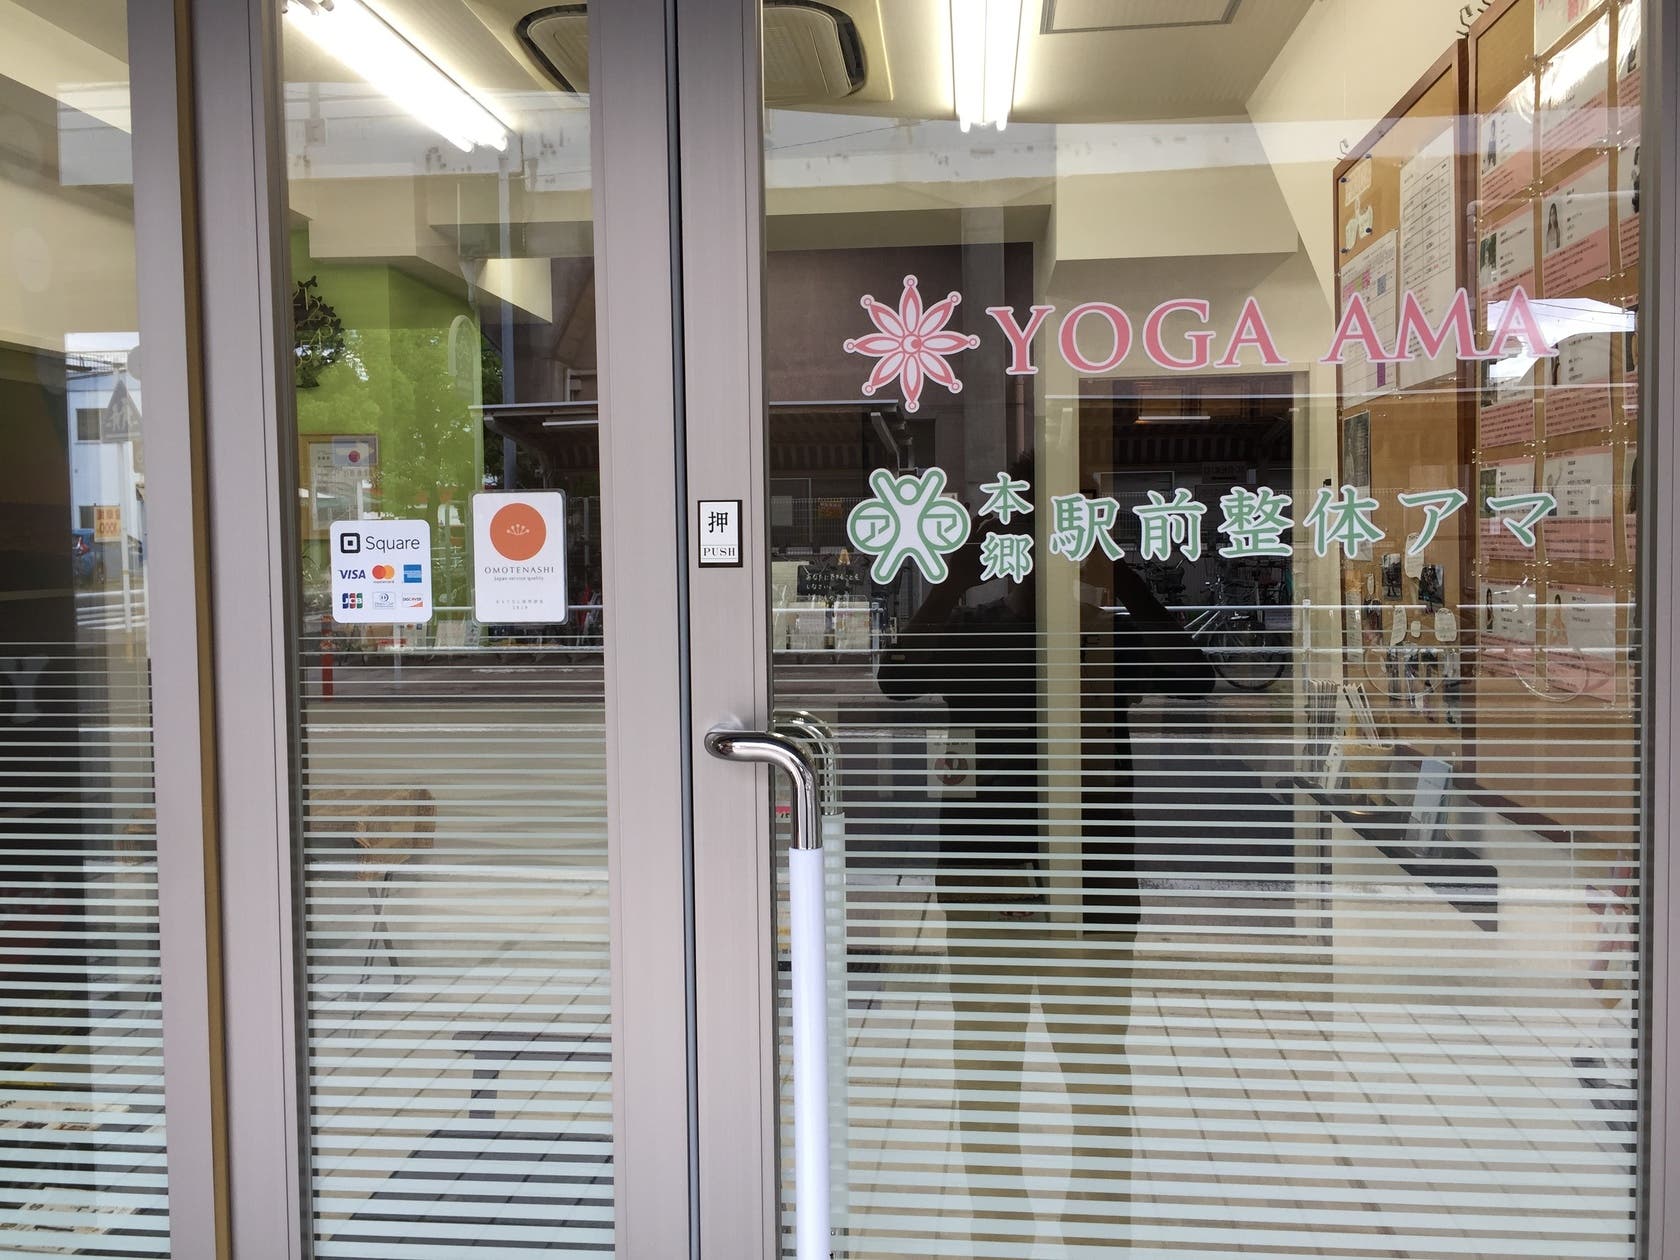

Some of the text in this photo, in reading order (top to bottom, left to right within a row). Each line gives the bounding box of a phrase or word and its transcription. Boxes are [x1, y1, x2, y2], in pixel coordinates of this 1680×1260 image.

[985, 297, 1290, 375] YOGA
[1319, 284, 1561, 365] AMA
[708, 511, 729, 533] 押
[979, 471, 1035, 584] 本郷
[1048, 483, 1558, 562] 駅前整体アマ
[365, 535, 420, 554] Square
[703, 547, 735, 557] PUSH
[339, 569, 366, 580] VISA
[484, 566, 554, 574] OMOTENASHI
